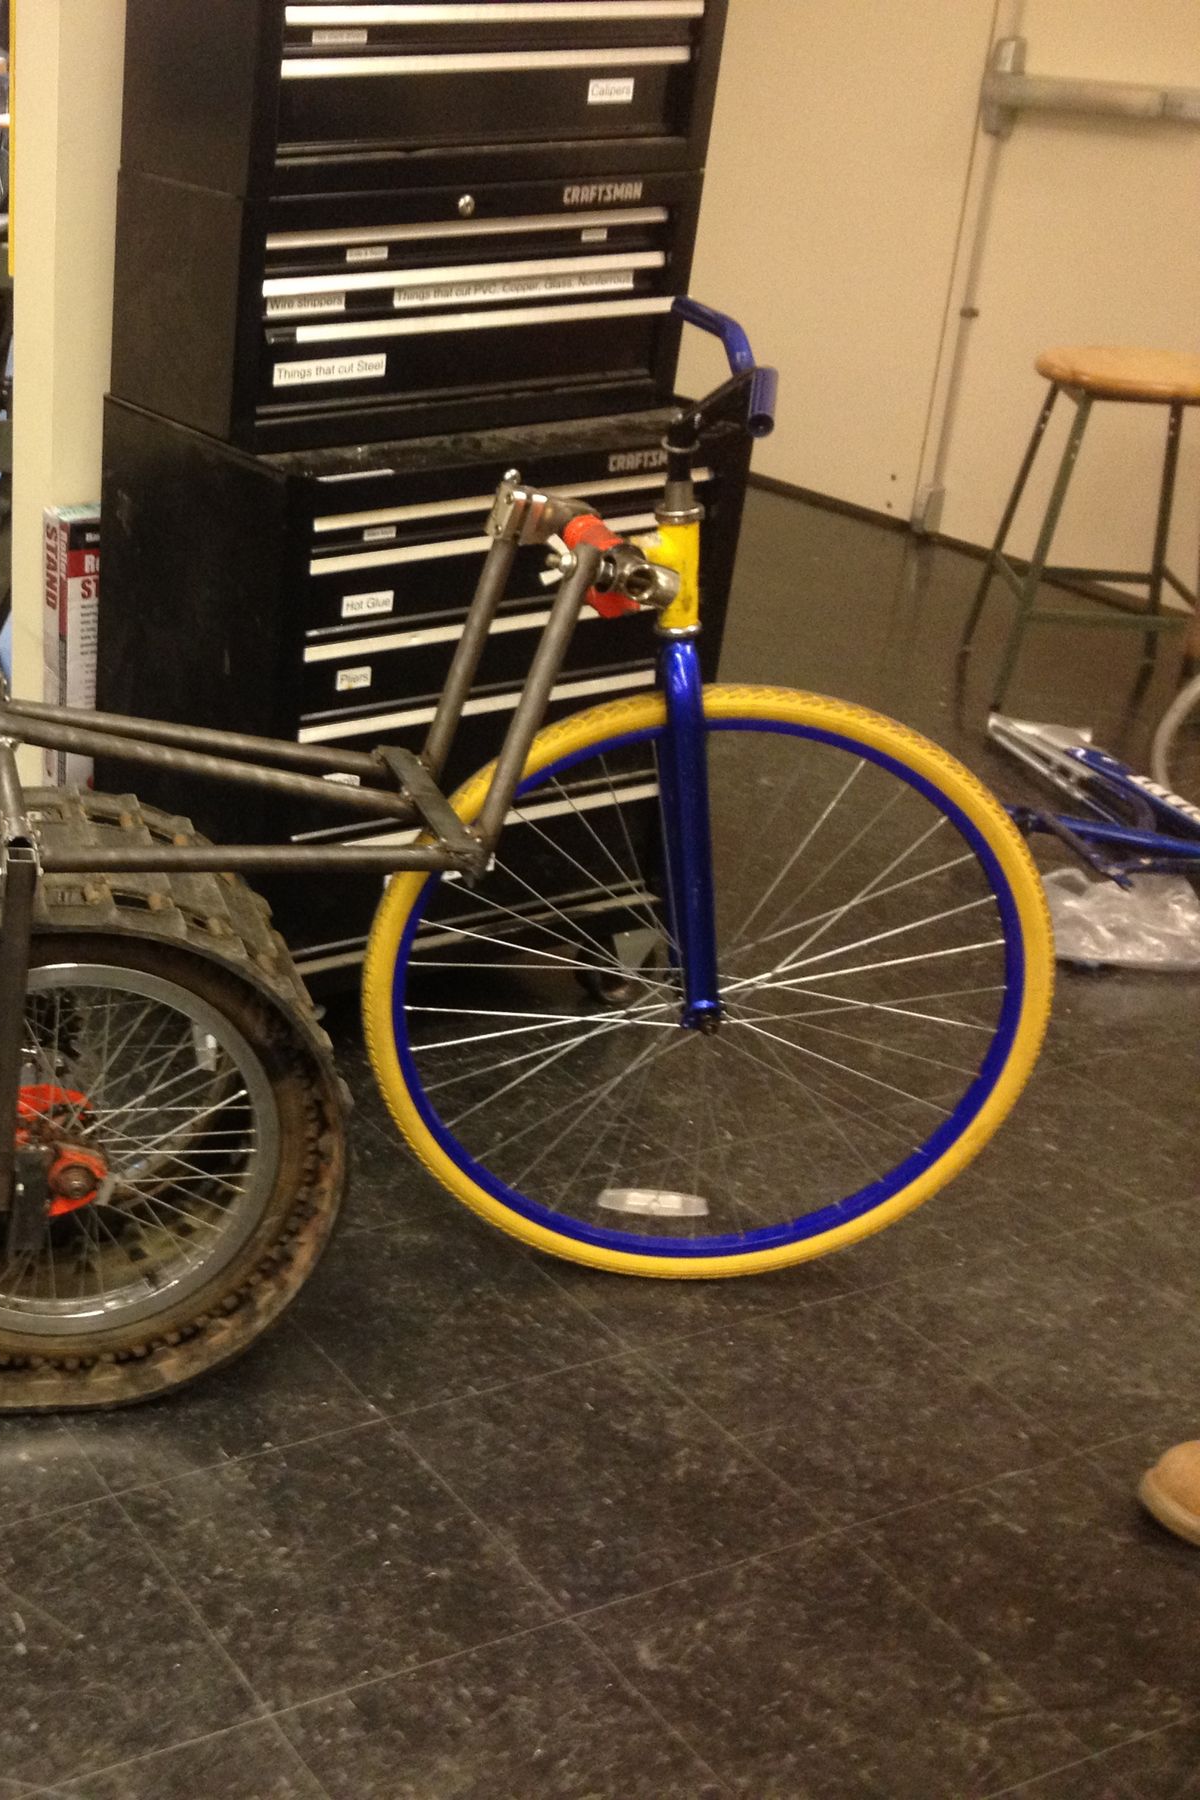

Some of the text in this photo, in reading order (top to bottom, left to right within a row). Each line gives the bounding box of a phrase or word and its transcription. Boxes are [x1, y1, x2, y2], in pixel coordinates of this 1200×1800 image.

[591, 83, 631, 97] Calipers
[563, 181, 643, 205] CRAFTSMAN
[277, 359, 384, 380] Things that cut Steel
[608, 449, 669, 472] CRAFTSM
[46, 523, 58, 610] STAND
[346, 596, 391, 611] Hot Glue
[340, 671, 369, 685] Pliers
